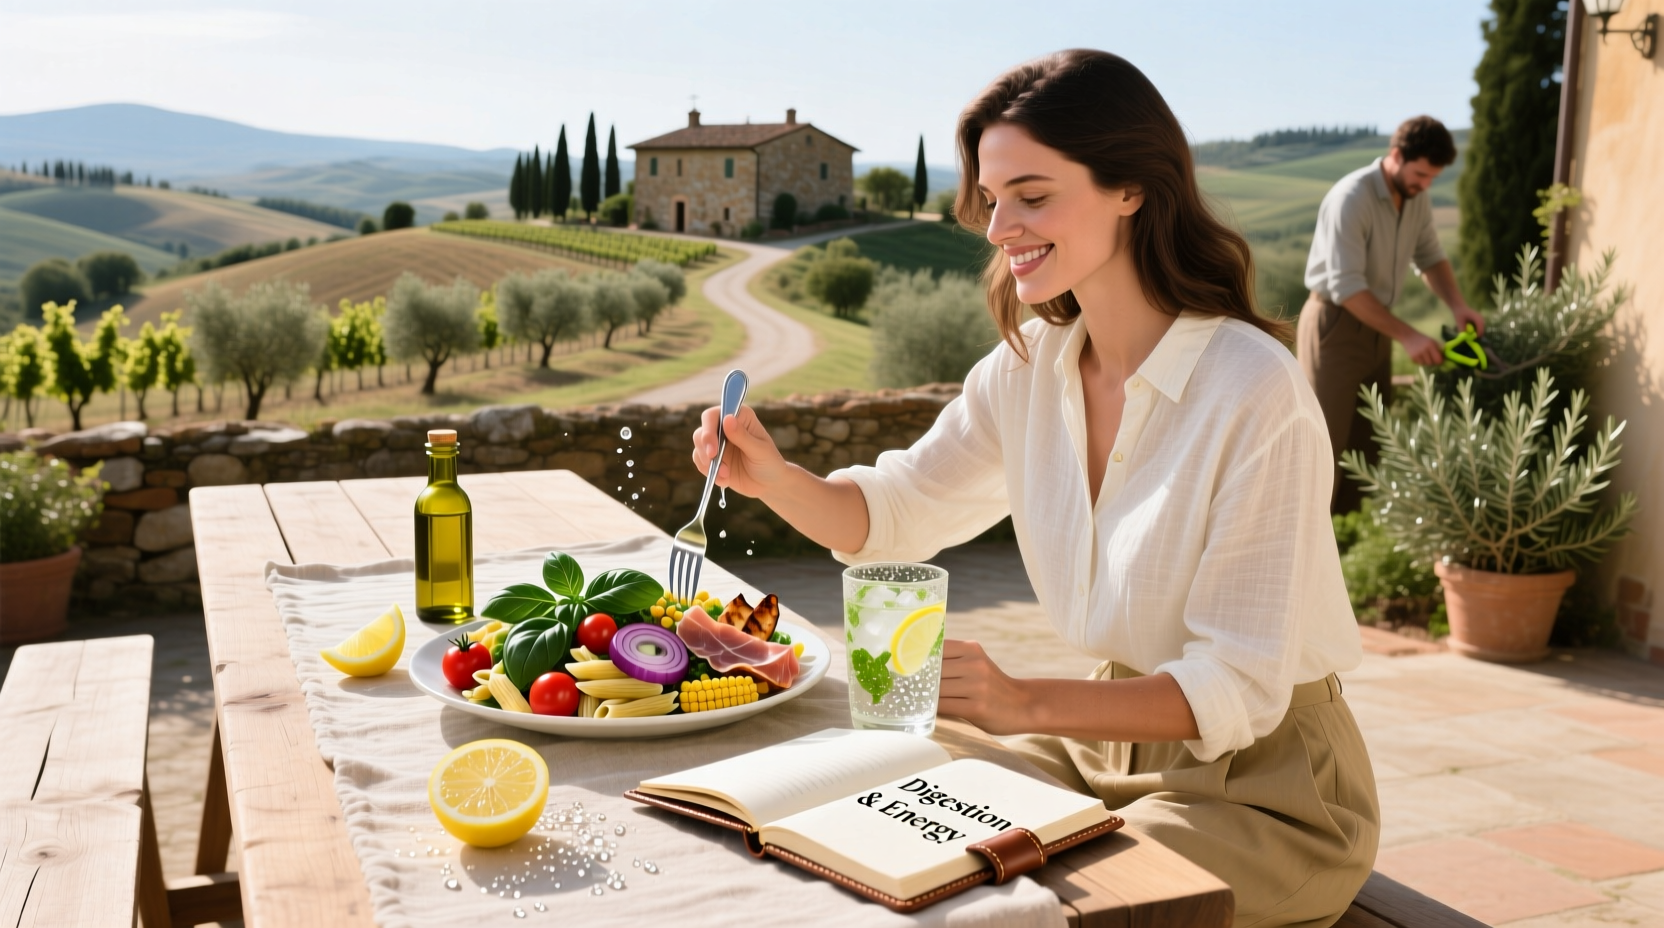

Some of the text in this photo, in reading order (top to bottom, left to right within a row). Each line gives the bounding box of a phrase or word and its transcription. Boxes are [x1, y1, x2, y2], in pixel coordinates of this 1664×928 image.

[857, 792, 967, 844] & Energy
[898, 778, 1012, 831] Digestion
